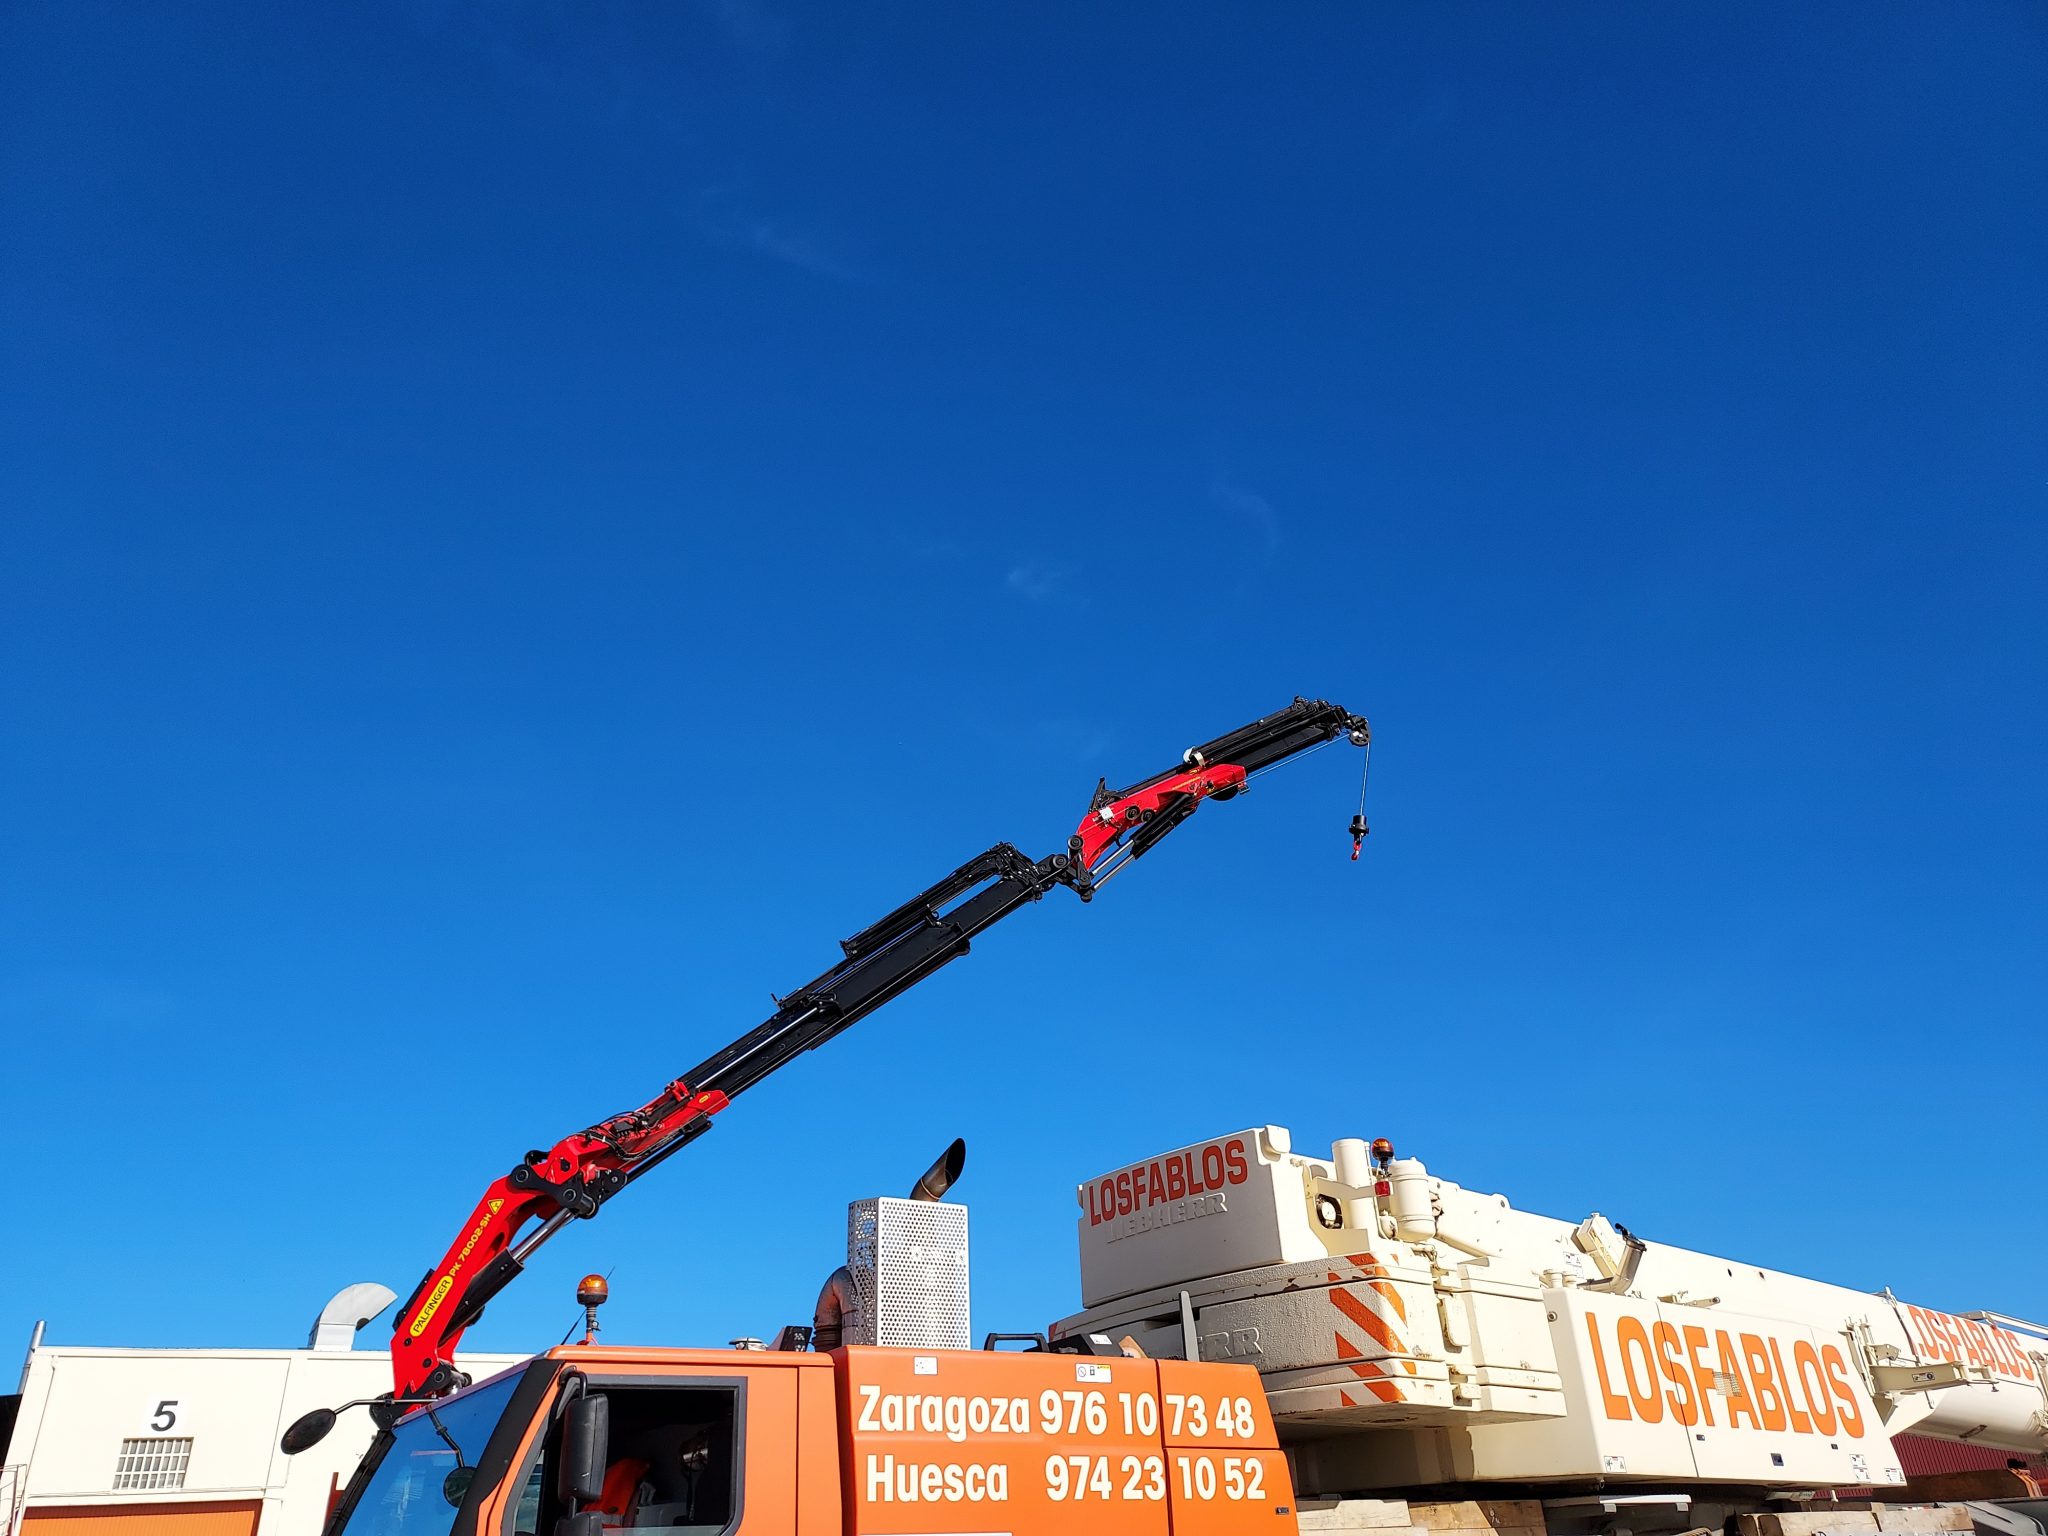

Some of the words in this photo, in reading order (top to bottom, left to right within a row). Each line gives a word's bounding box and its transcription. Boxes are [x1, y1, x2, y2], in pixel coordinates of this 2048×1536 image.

[1089, 1139, 1248, 1226] LOSFABLOS
[413, 1279, 450, 1333] PALFINGER
[449, 1262, 462, 1277] PK
[1585, 1312, 1865, 1438] LOSFABLOS
[1907, 1305, 2034, 1381] OSFABLOS
[150, 1400, 179, 1432] 5
[858, 1385, 1030, 1442] Zaragoza
[1039, 1389, 1108, 1435] 976
[1118, 1392, 1158, 1436] 10
[1165, 1394, 1208, 1437] 73
[1215, 1397, 1256, 1438] 48
[867, 1454, 1008, 1502] Huesca
[1045, 1454, 1113, 1501] 974
[1120, 1455, 1166, 1501] 23
[1177, 1456, 1216, 1500] 10
[1223, 1457, 1266, 1500] 52
